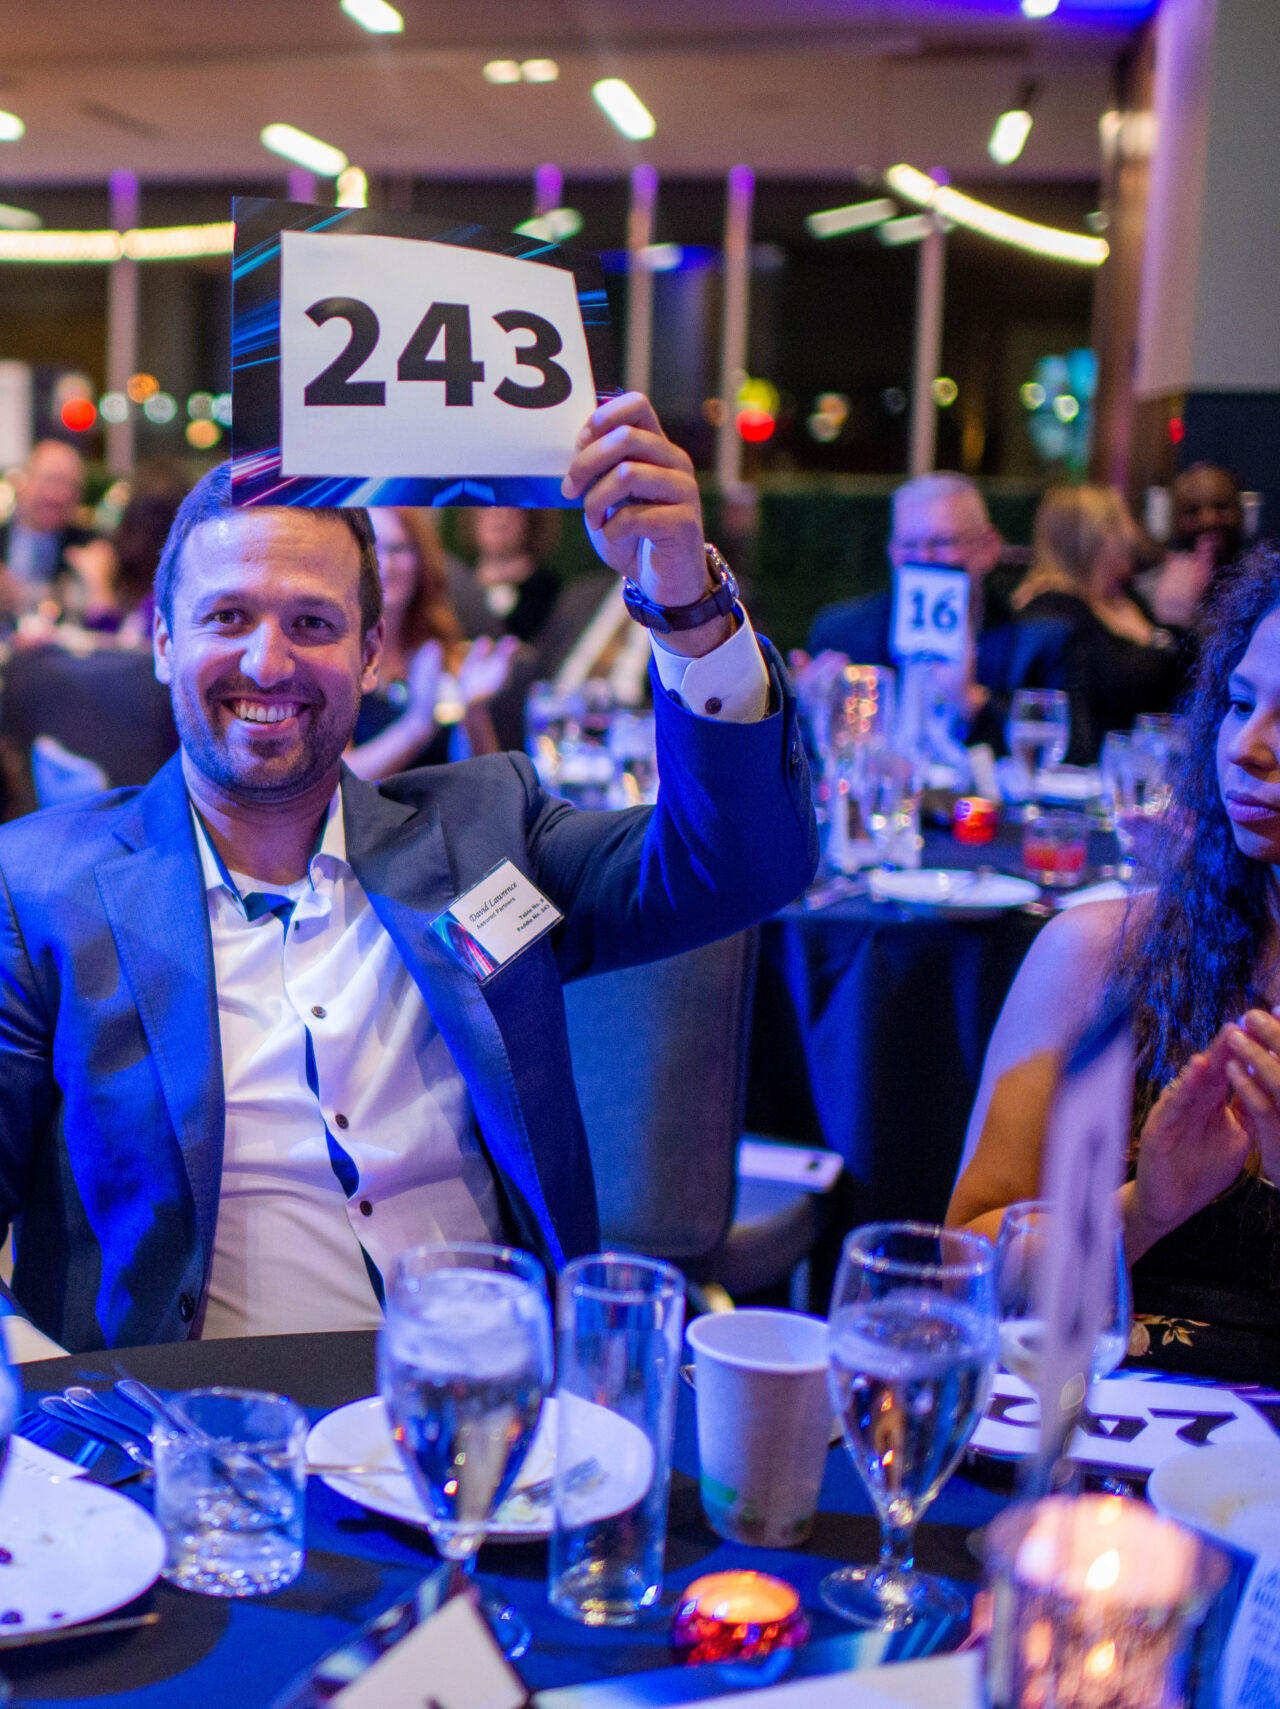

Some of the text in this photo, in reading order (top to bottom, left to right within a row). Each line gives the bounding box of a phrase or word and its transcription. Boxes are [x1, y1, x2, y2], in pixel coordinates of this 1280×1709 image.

[304, 296, 573, 410] 243
[910, 587, 959, 633] 16
[469, 882, 517, 922] David Lawrence
